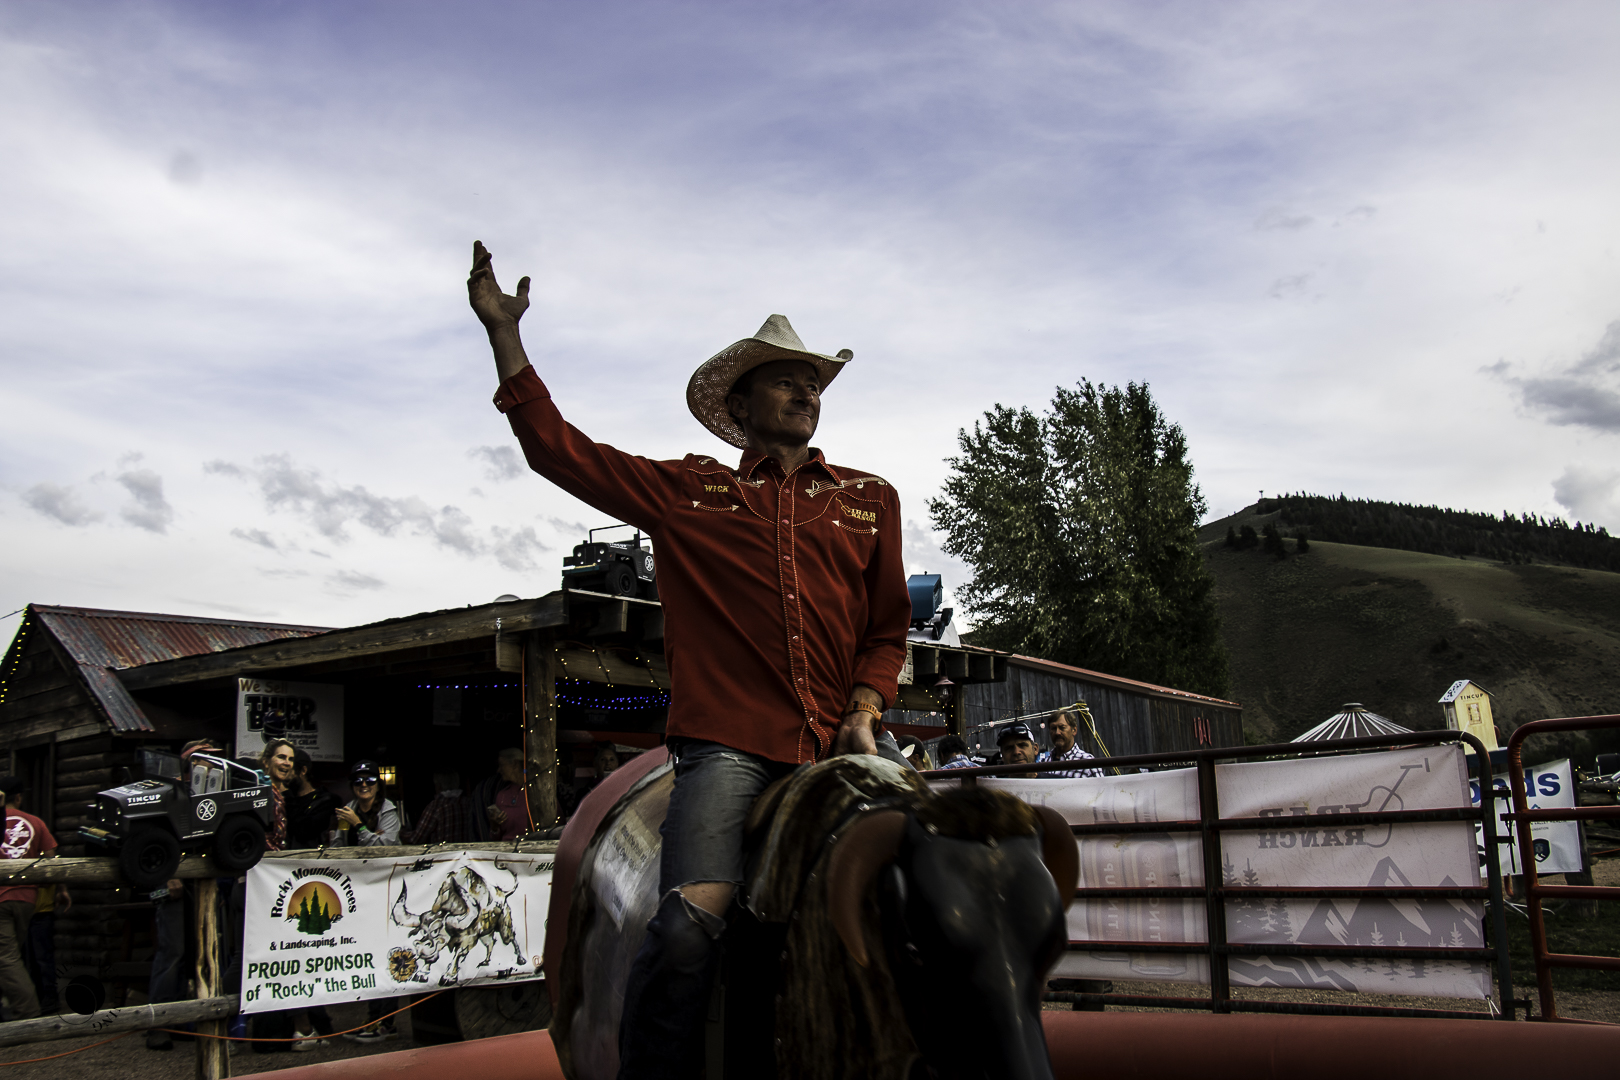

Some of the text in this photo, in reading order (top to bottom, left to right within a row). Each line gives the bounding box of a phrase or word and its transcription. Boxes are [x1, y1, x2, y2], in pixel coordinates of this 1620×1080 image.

[704, 485, 729, 493] WICK
[241, 680, 288, 693] We Sell
[244, 694, 316, 717] THIRD
[127, 794, 161, 804] TINCUP
[232, 790, 261, 799] TINCUP
[270, 866, 357, 918] Rocky Mountain Trees
[269, 936, 357, 951] & Landscaping, Inc.
[247, 952, 375, 980] PROUD SPONSOR
[245, 973, 376, 1002] of "Rocky" the Bull
